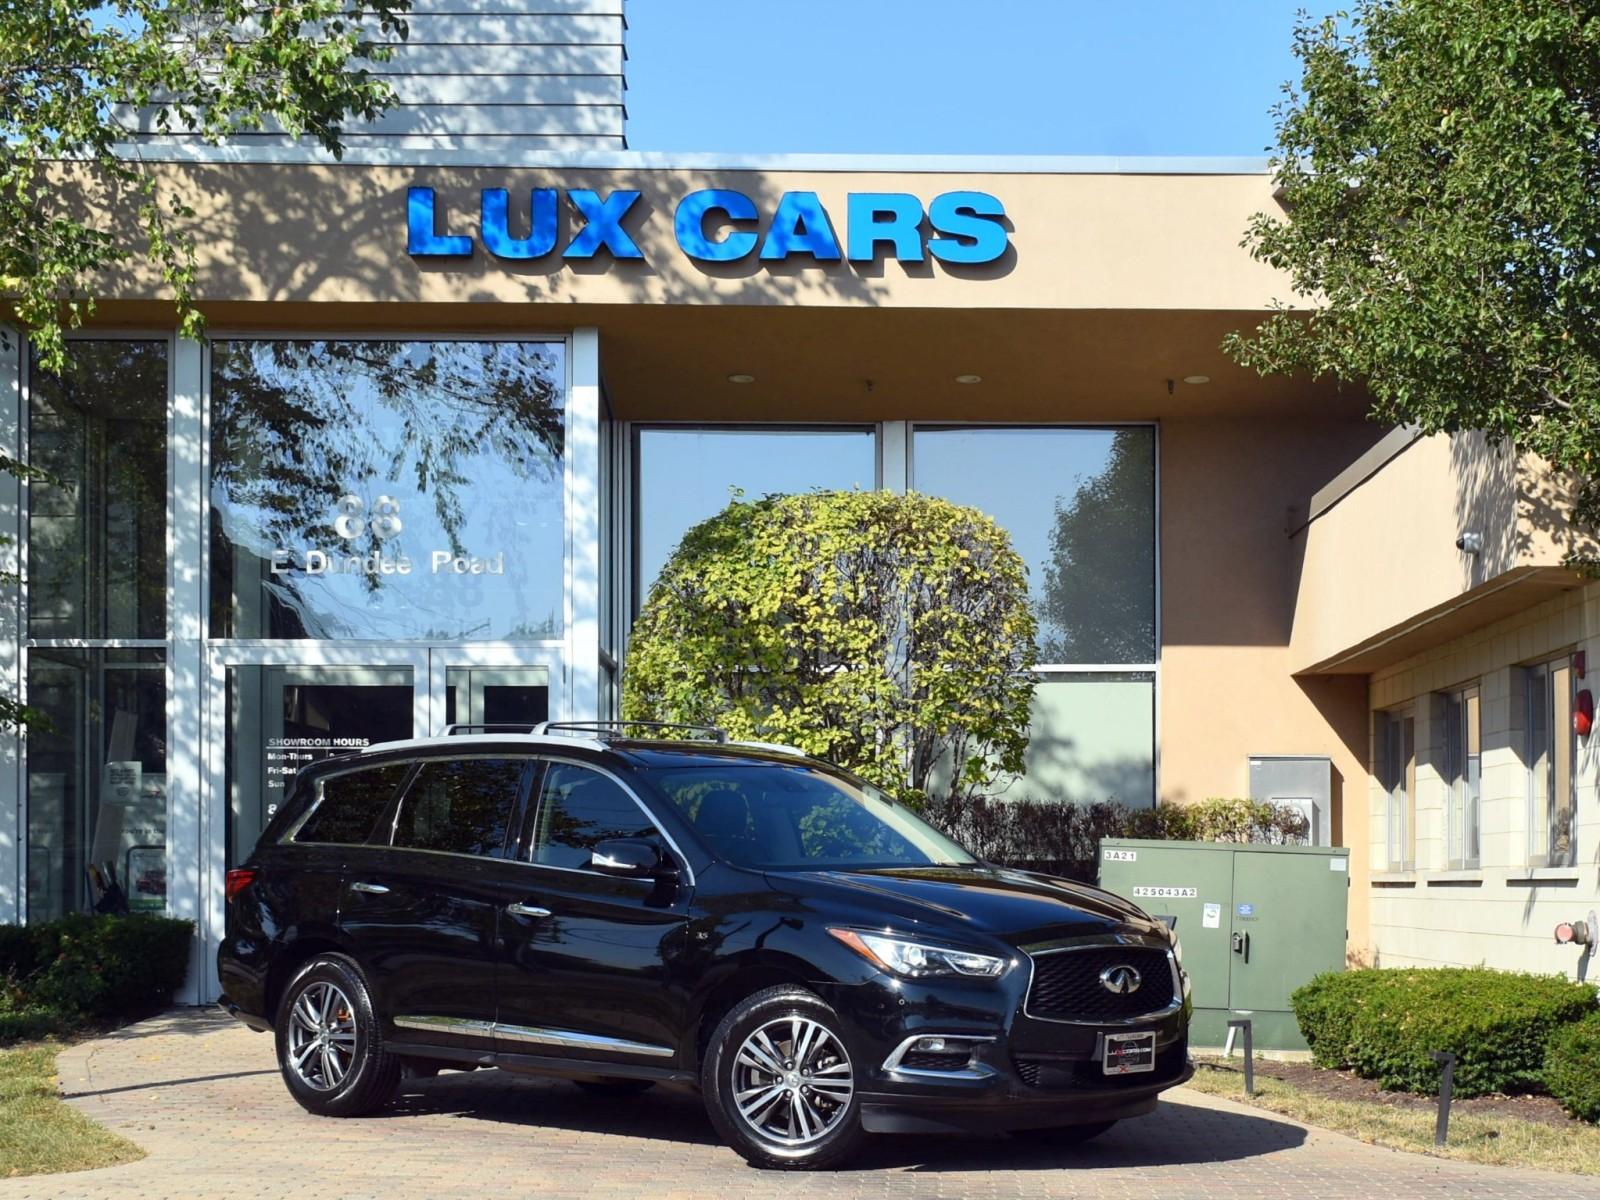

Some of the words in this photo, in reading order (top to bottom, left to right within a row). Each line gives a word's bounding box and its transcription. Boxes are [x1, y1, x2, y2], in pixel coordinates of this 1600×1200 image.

[406, 186, 645, 260] LUX
[674, 188, 1009, 264] CARS
[334, 494, 402, 539] 88
[270, 550, 289, 574] E
[306, 550, 412, 575] Dundee
[431, 550, 505, 575] Road
[268, 738, 331, 746] SHOWROOM
[333, 738, 370, 746] HOURS
[268, 780, 285, 788] Sun
[1105, 851, 1135, 860] 3A21
[1134, 888, 1196, 897] 425043A2
